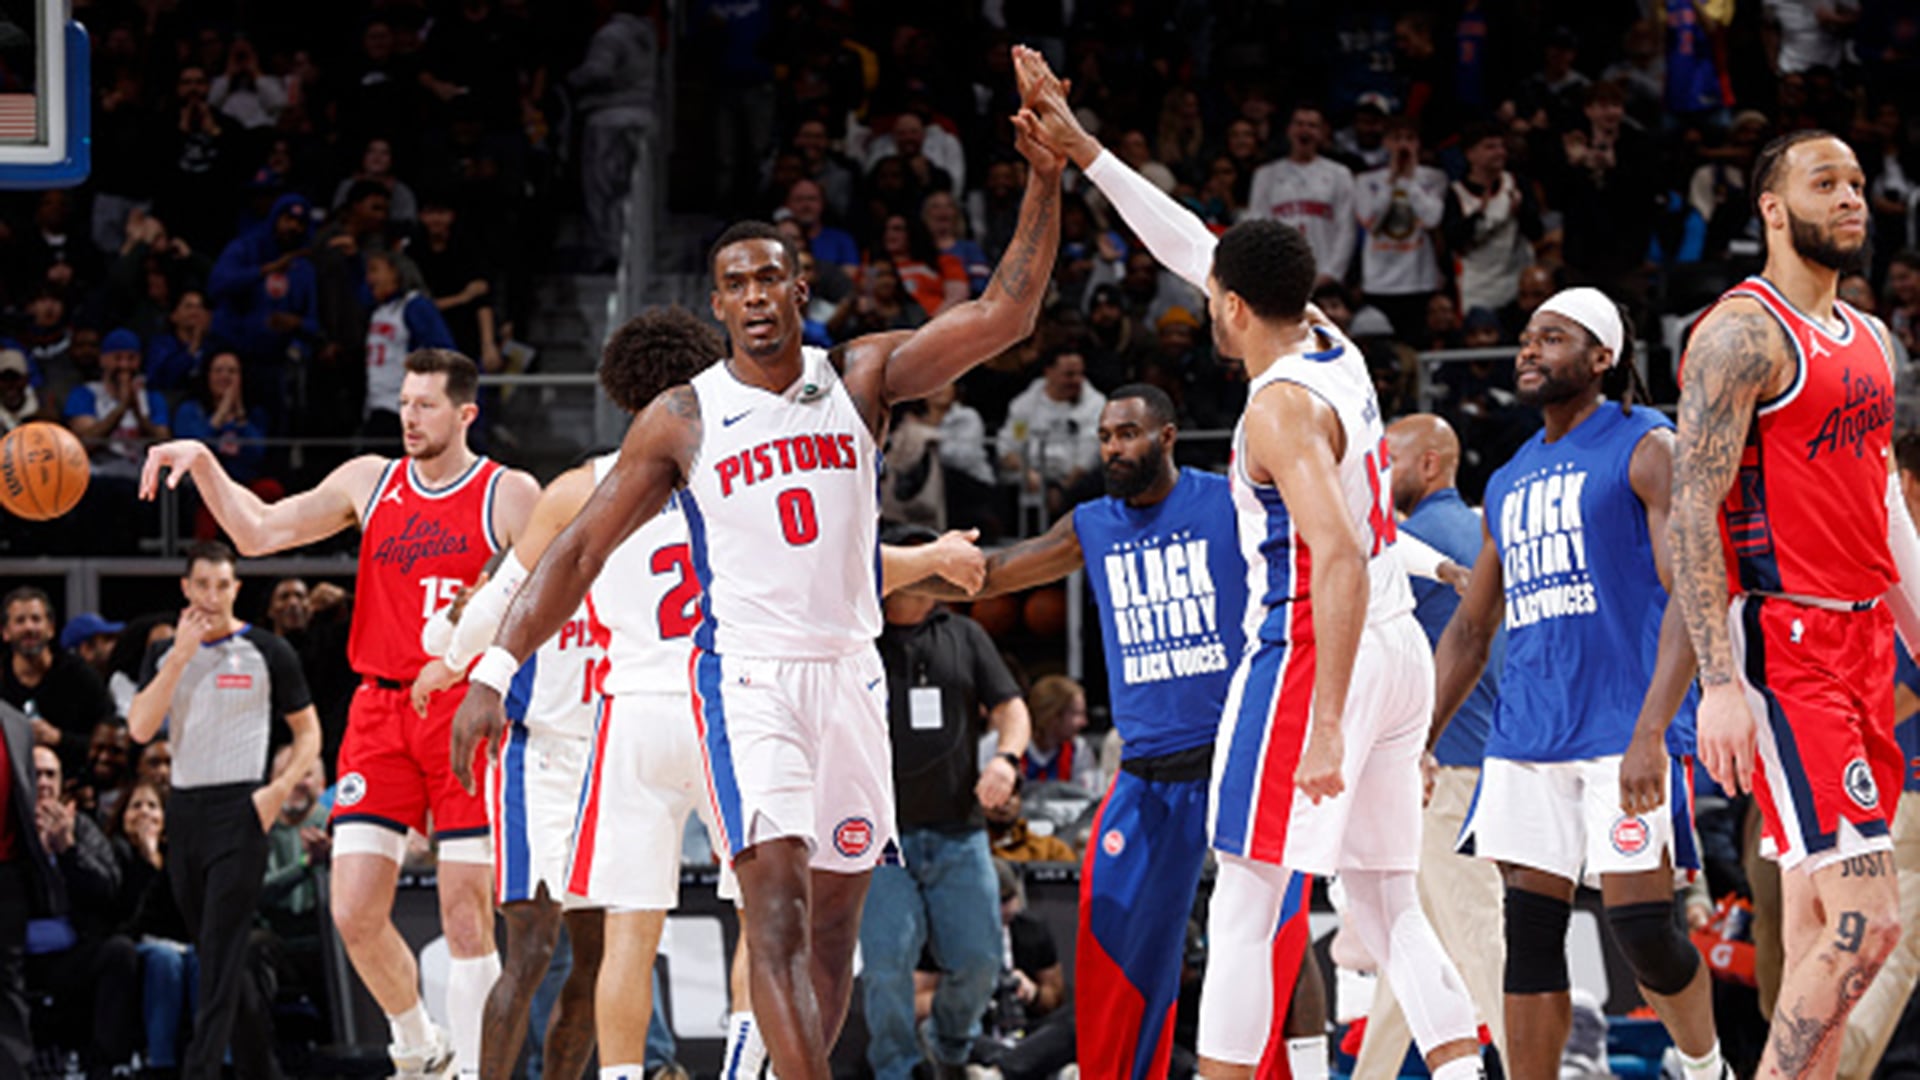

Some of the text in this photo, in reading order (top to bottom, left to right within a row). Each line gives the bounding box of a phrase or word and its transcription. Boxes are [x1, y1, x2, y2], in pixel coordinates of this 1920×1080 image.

[1842, 367, 1879, 410] Los
[714, 433, 857, 498] PISTONS
[399, 511, 440, 541] Los
[777, 487, 819, 546] 0
[373, 527, 469, 575] Angeles
[1104, 538, 1216, 609] BLACK
[651, 542, 705, 641] 2
[1114, 594, 1217, 645] HISTORY
[1710, 942, 1734, 969] G
[1833, 910, 1867, 955] 9
